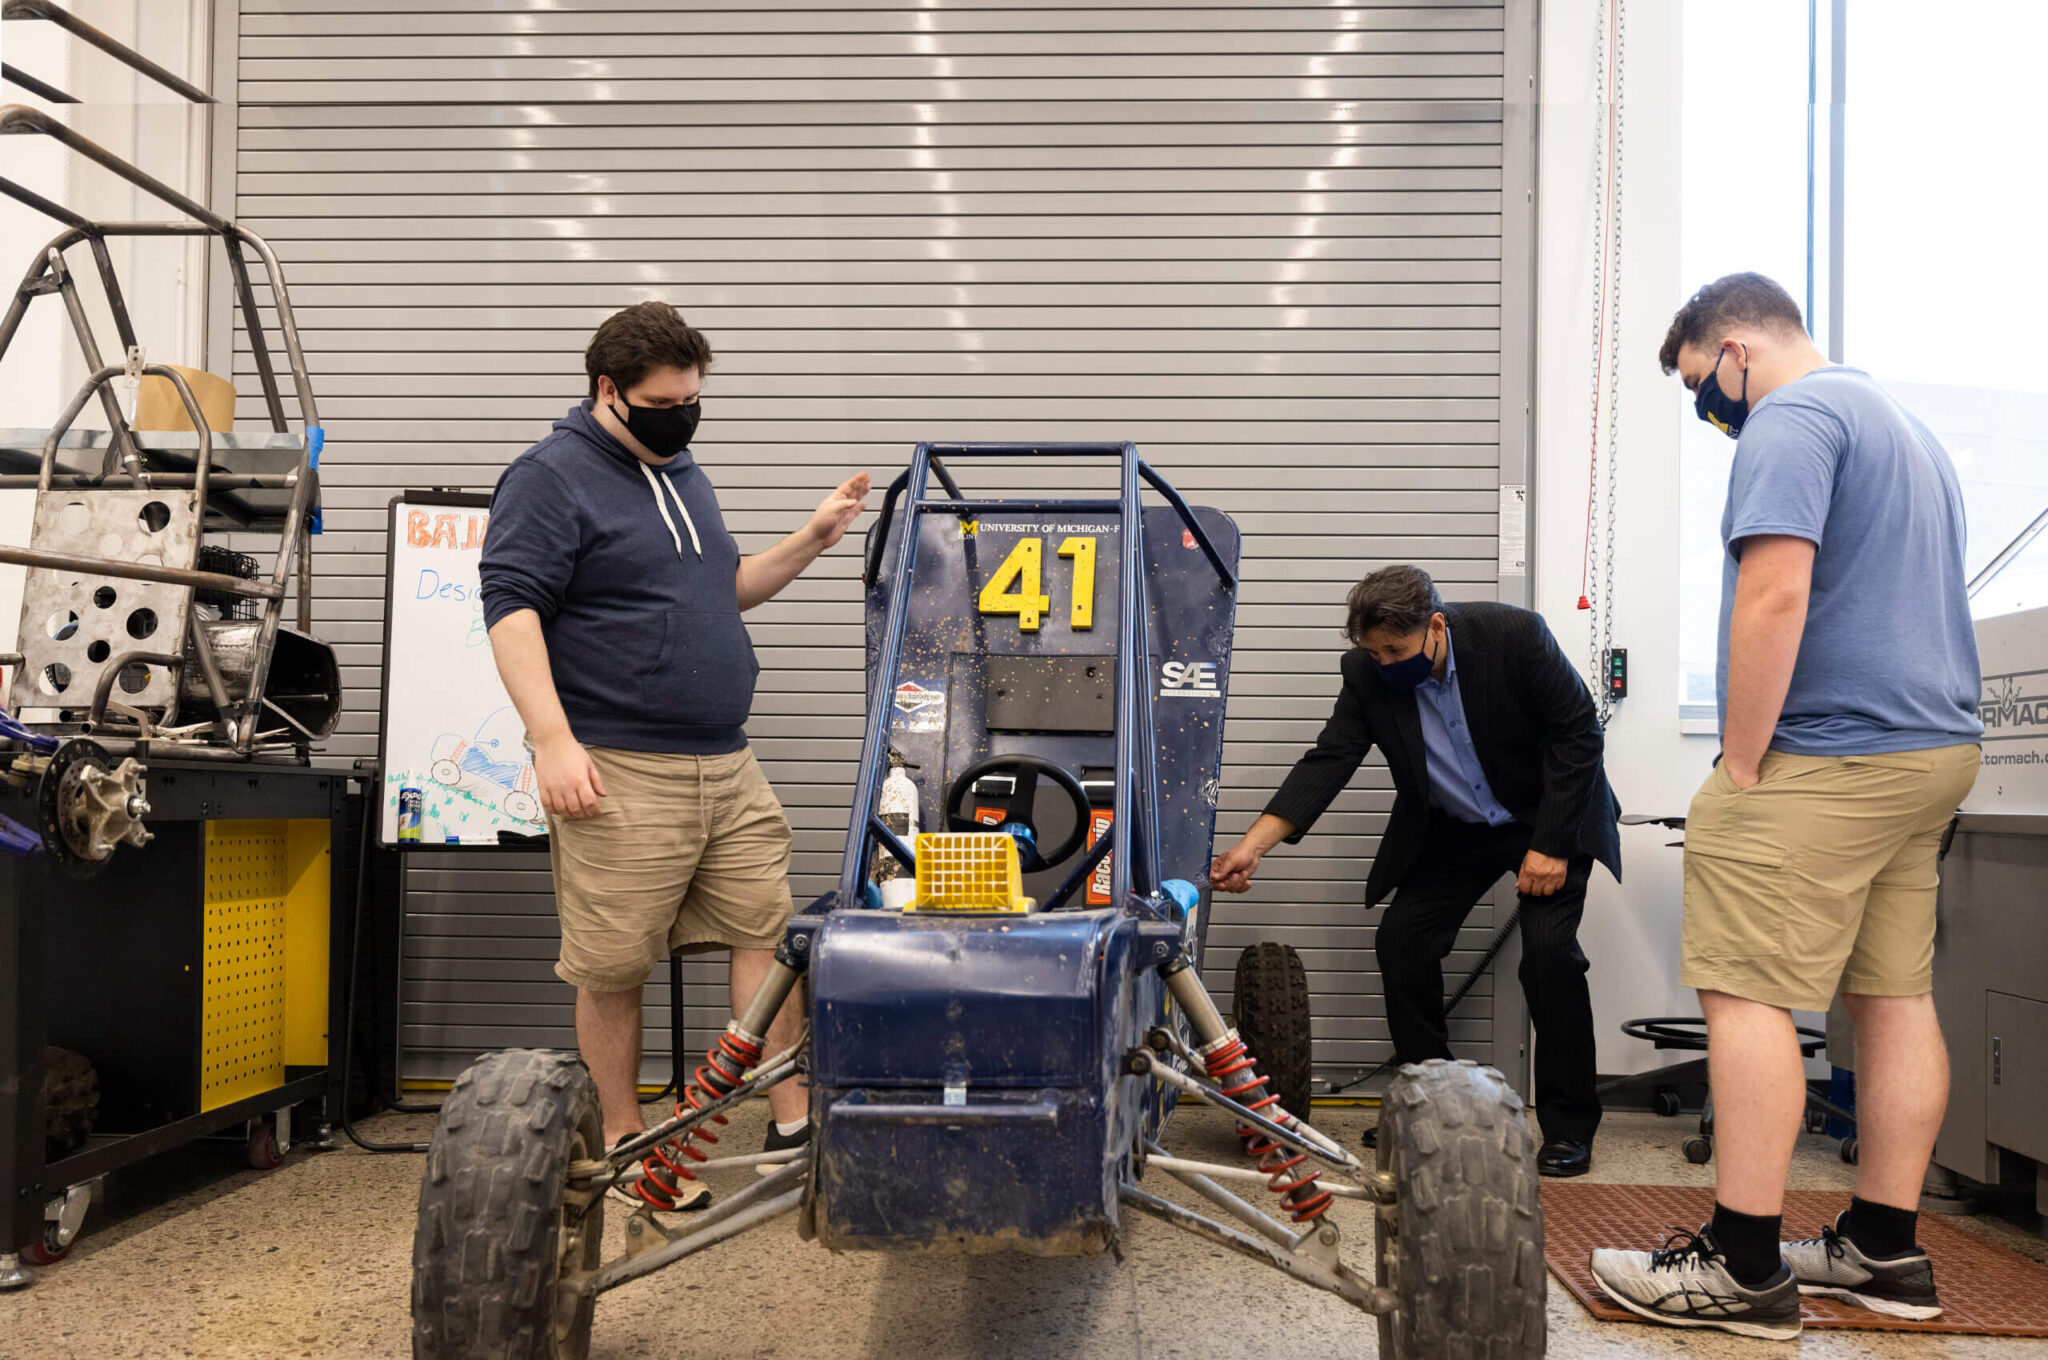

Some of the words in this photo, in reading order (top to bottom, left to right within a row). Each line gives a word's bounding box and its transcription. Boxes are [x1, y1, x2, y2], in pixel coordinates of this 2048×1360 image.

[980, 523, 1039, 533] UNIVERSITY
[1041, 523, 1055, 533] OF
[1057, 523, 1120, 533] MICHIGAN-F
[978, 536, 1096, 632] 41
[1161, 661, 1217, 688] SAE
